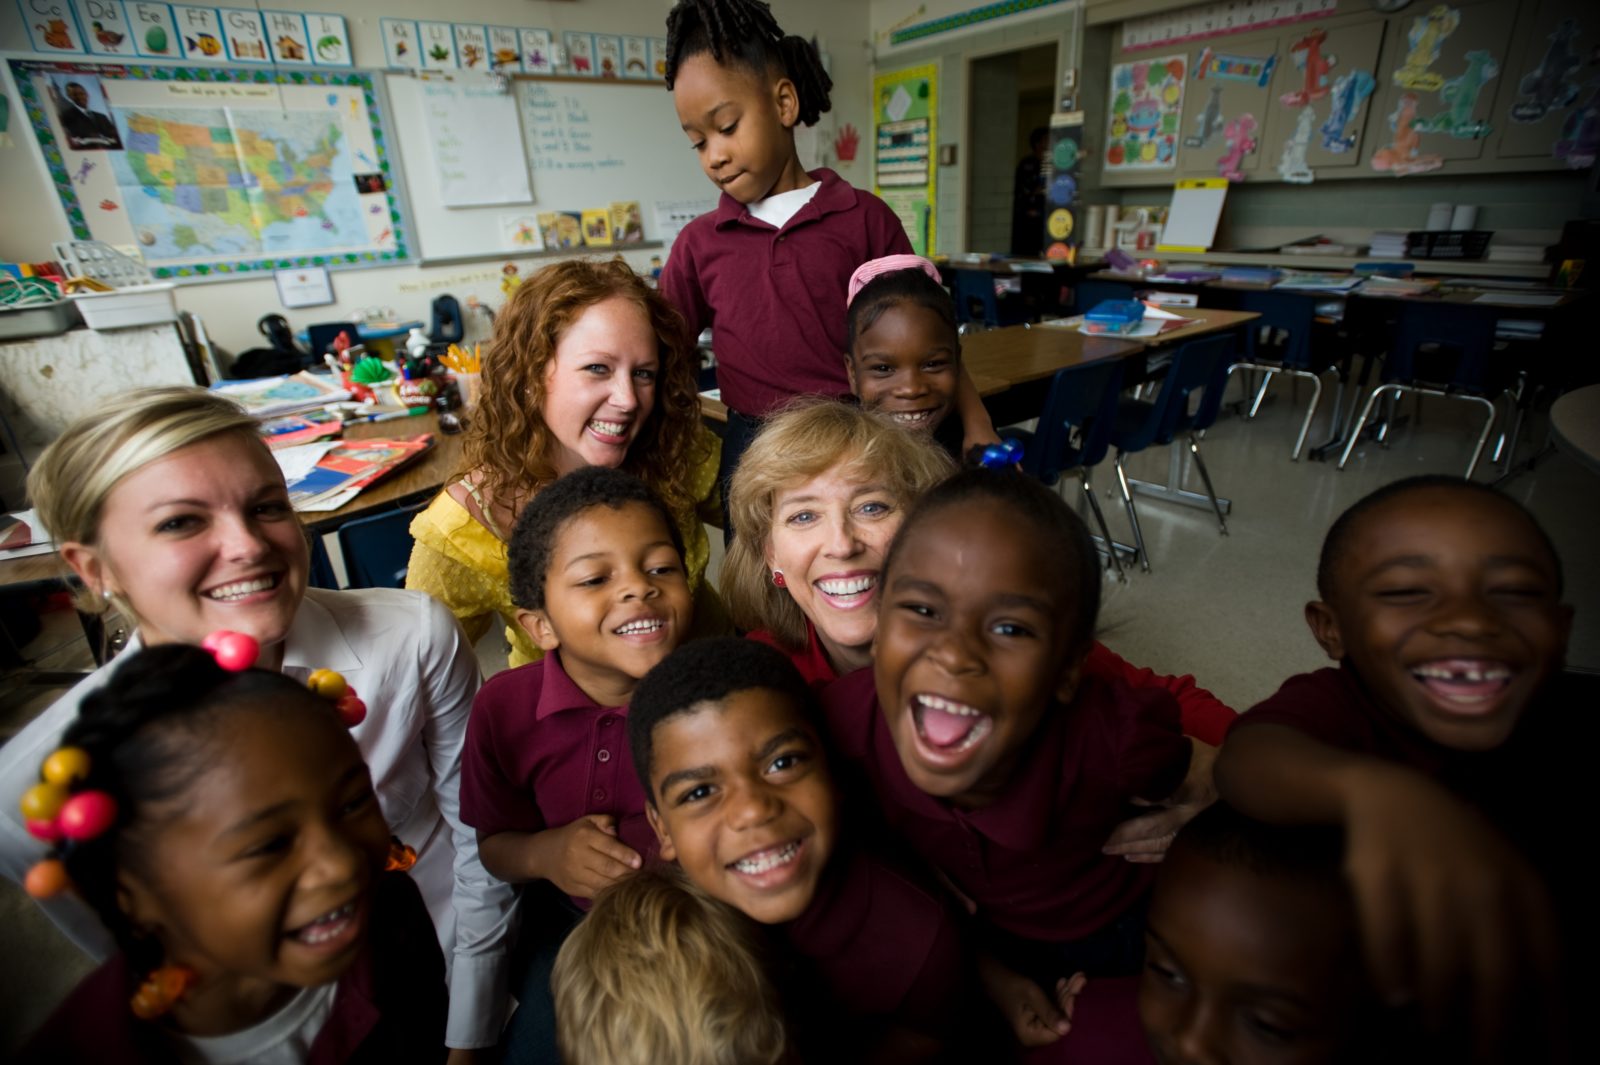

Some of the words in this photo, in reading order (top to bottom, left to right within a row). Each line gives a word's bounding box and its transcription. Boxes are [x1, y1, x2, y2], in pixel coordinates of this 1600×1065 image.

[136, 3, 161, 23] Ee
[186, 8, 210, 27] Ff
[1271, 6, 1280, 18] 7
[1295, 1, 1304, 14] 8
[228, 11, 258, 36] Gg
[272, 14, 299, 32] Hh
